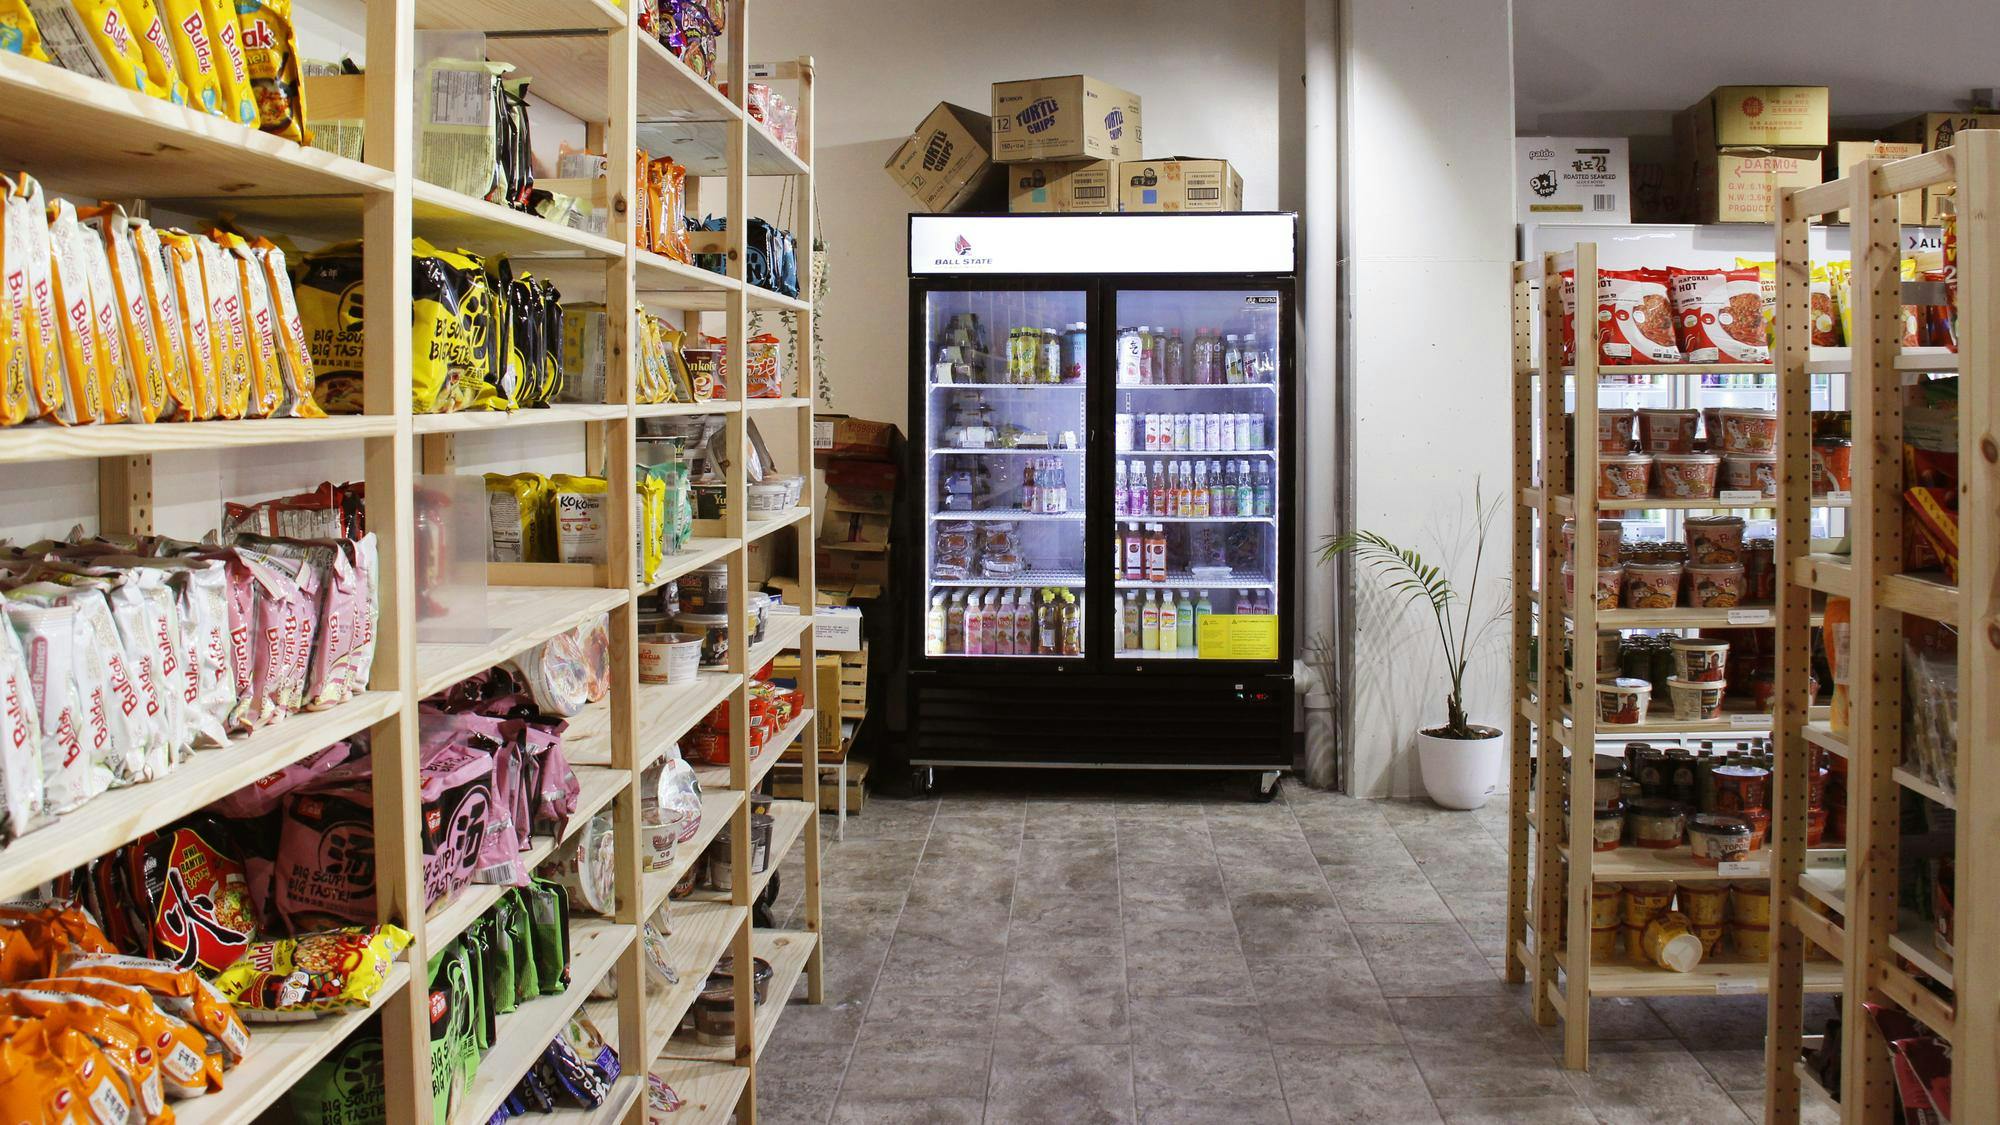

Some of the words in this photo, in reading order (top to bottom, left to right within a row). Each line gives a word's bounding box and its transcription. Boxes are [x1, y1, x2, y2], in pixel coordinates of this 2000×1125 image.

[104, 10, 127, 57] Bul
[146, 17, 174, 71] Buldak
[182, 10, 212, 75] Buldak
[220, 24, 245, 83] Buldak
[997, 118, 1009, 130] 12
[1016, 99, 1059, 127] TURTLE
[1027, 115, 1056, 134] CHIPS
[1104, 110, 1124, 131] TURTLE
[1109, 127, 1122, 141] CHIPS
[1960, 118, 1978, 130] 20
[922, 130, 948, 171] TURTLE
[934, 141, 954, 172] CHIPS
[1529, 149, 1555, 160] paldo
[1744, 159, 1798, 169] DARM04
[912, 175, 924, 189] 12
[1540, 187, 1554, 195] free
[8, 270, 23, 339] Buldak
[1679, 283, 1697, 292] HOT
[34, 278, 50, 346] Buldak
[71, 299, 93, 364] Buldak
[100, 304, 120, 364] Buldak
[224, 294, 243, 349] Buldak
[256, 308, 271, 359] Buldak
[194, 320, 210, 374] Buldak
[312, 345, 331, 356] BIG
[333, 345, 363, 356] TAST
[314, 330, 332, 341] BIG
[336, 330, 363, 342] SOU
[157, 616, 177, 677] Buldak
[266, 628, 278, 680] Buldak
[283, 616, 297, 672] Buldak
[328, 614, 340, 654] Buld
[184, 646, 199, 704] Buldak
[231, 626, 250, 688] Buldak
[90, 685, 108, 749] Buldak
[322, 1099, 341, 1113] BIG
